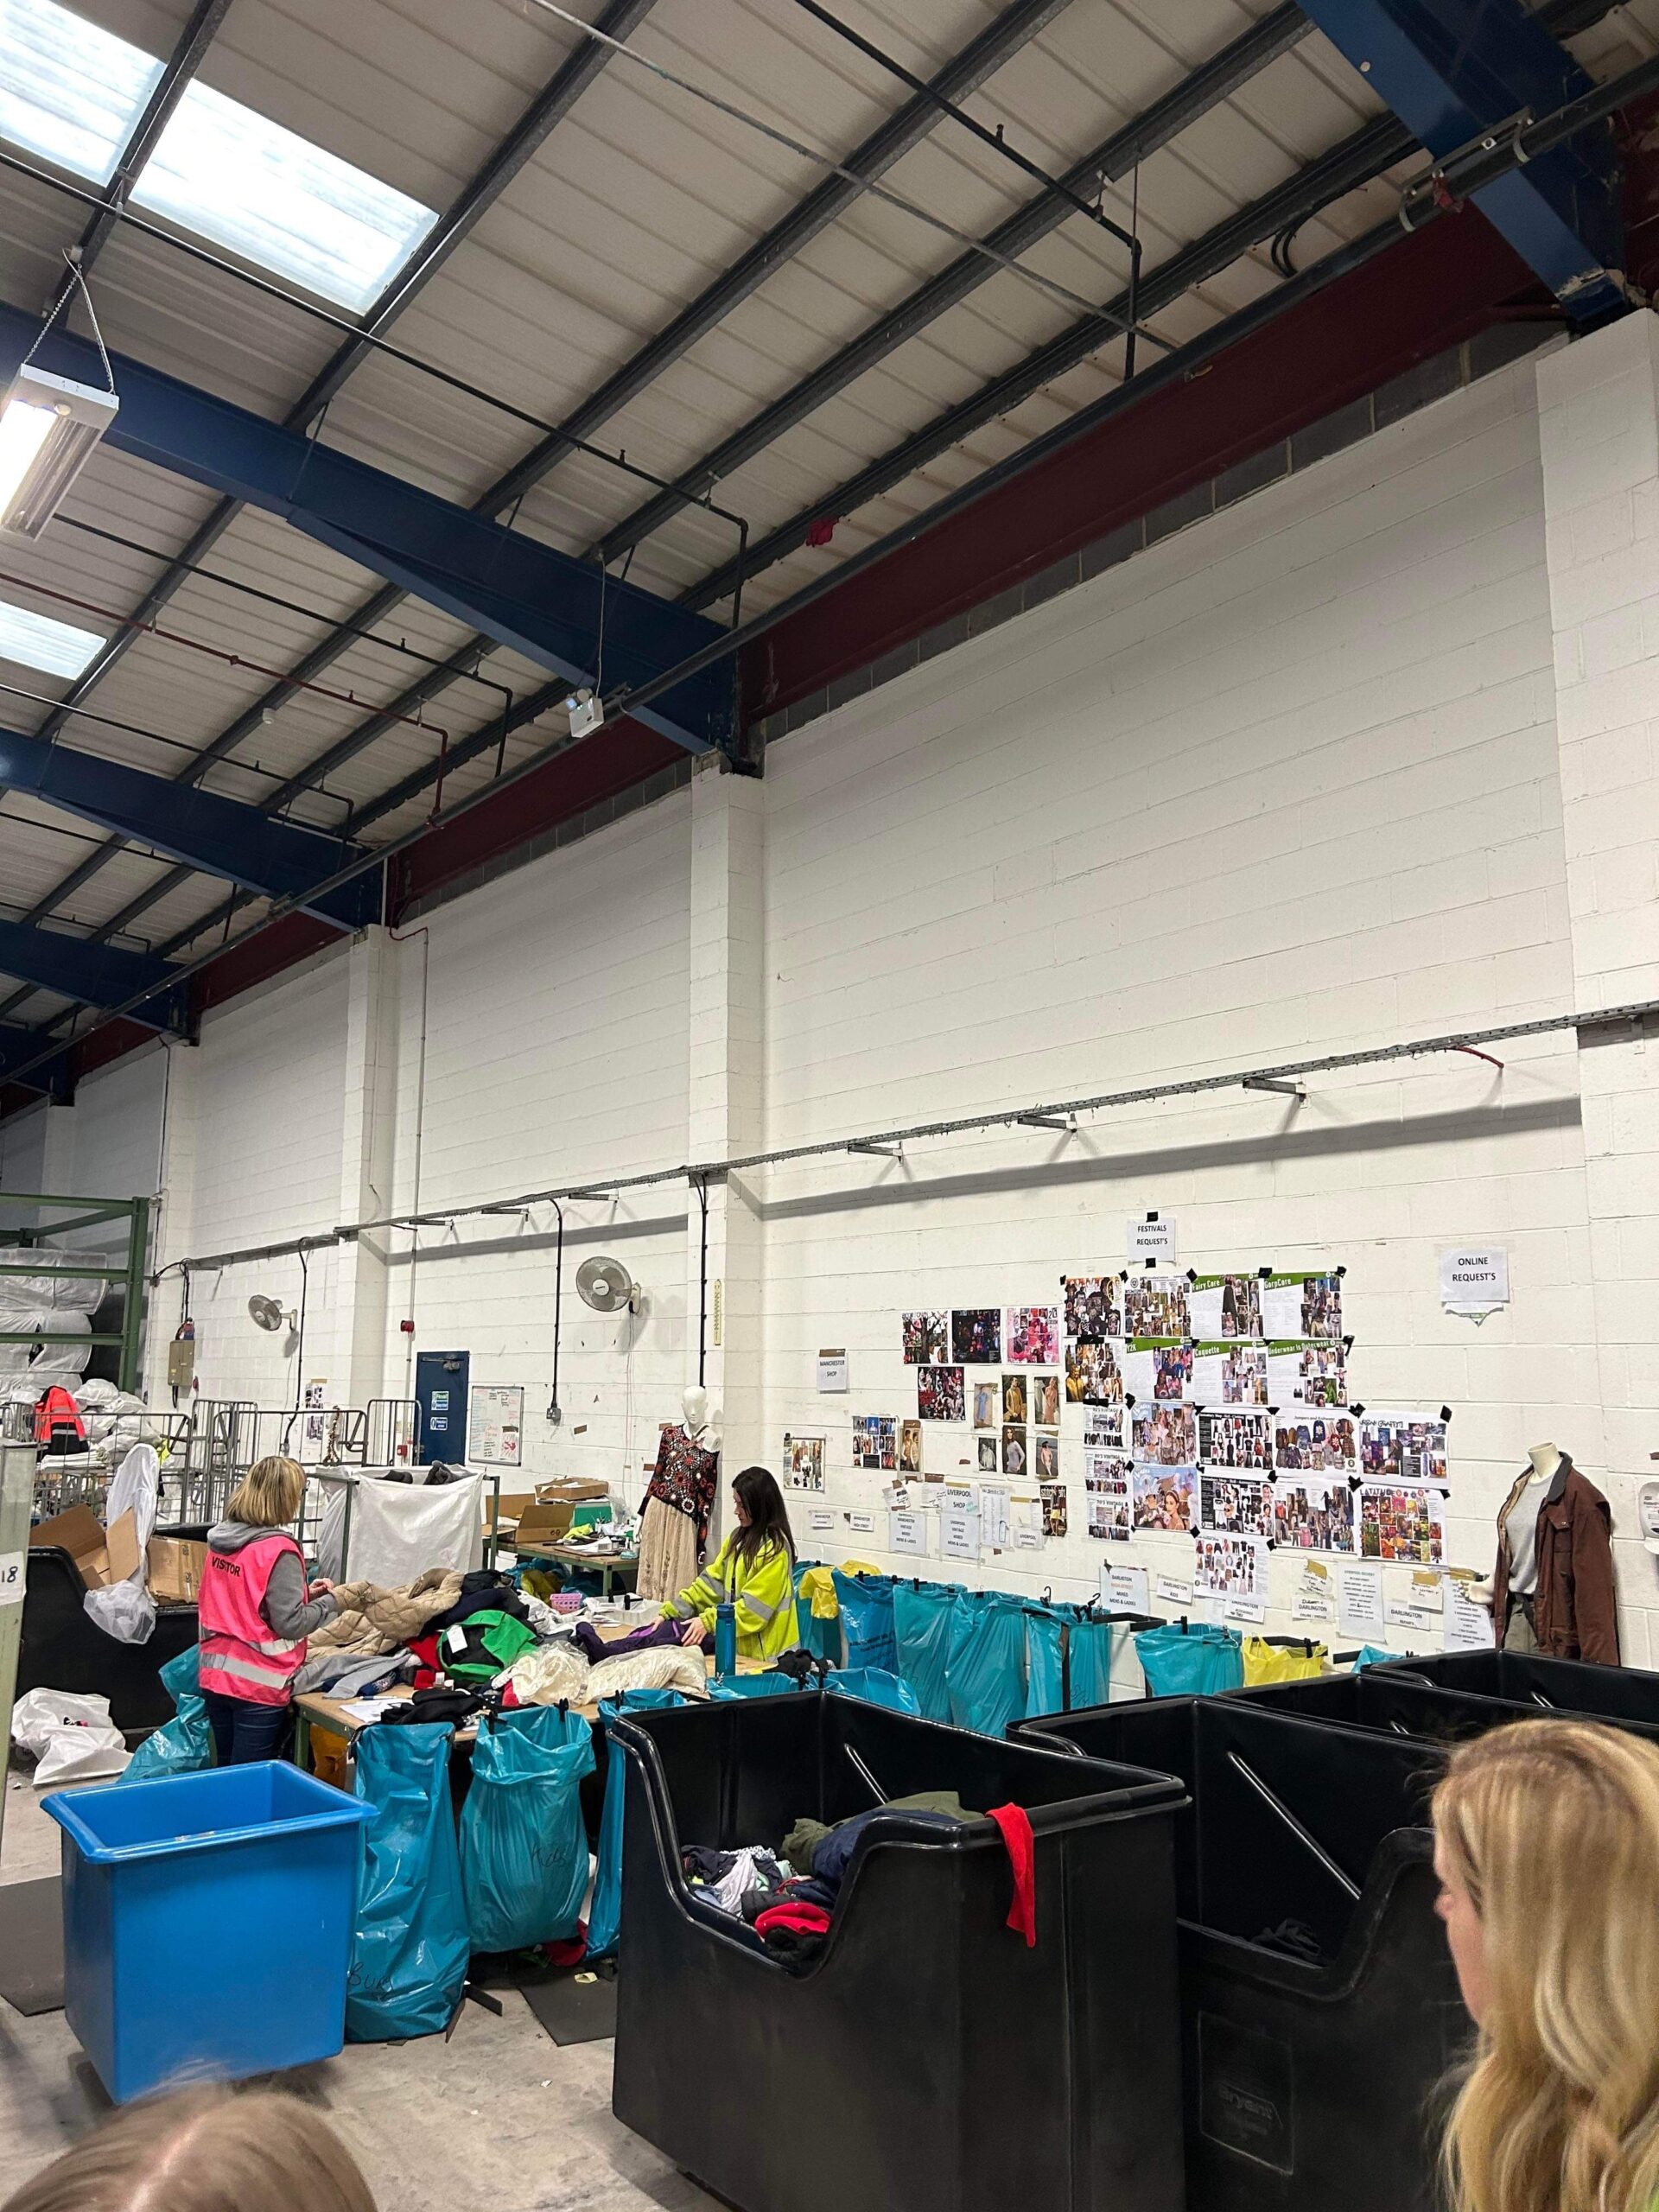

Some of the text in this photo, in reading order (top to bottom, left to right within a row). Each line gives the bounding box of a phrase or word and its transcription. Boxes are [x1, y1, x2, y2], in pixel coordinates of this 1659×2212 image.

[1136, 1237, 1168, 1246] REQUEST'S
[1458, 1256, 1489, 1266] ONLINE
[1452, 1272, 1497, 1282] REQUEST'S
[1192, 1281, 1206, 1291] Fairy
[1207, 1280, 1220, 1288] Core
[1264, 1278, 1292, 1289] GorpCore
[1126, 1344, 1137, 1352] Y2K
[1194, 1346, 1220, 1357] Coquette
[1268, 1345, 1295, 1355] Underwear
[947, 1489, 972, 1497] LIVERPOOL
[212, 1556, 241, 1577] VISITOR
[1163, 1580, 1188, 1592] DARLINGTON
[1390, 1608, 1422, 1619] DARLINGTON
